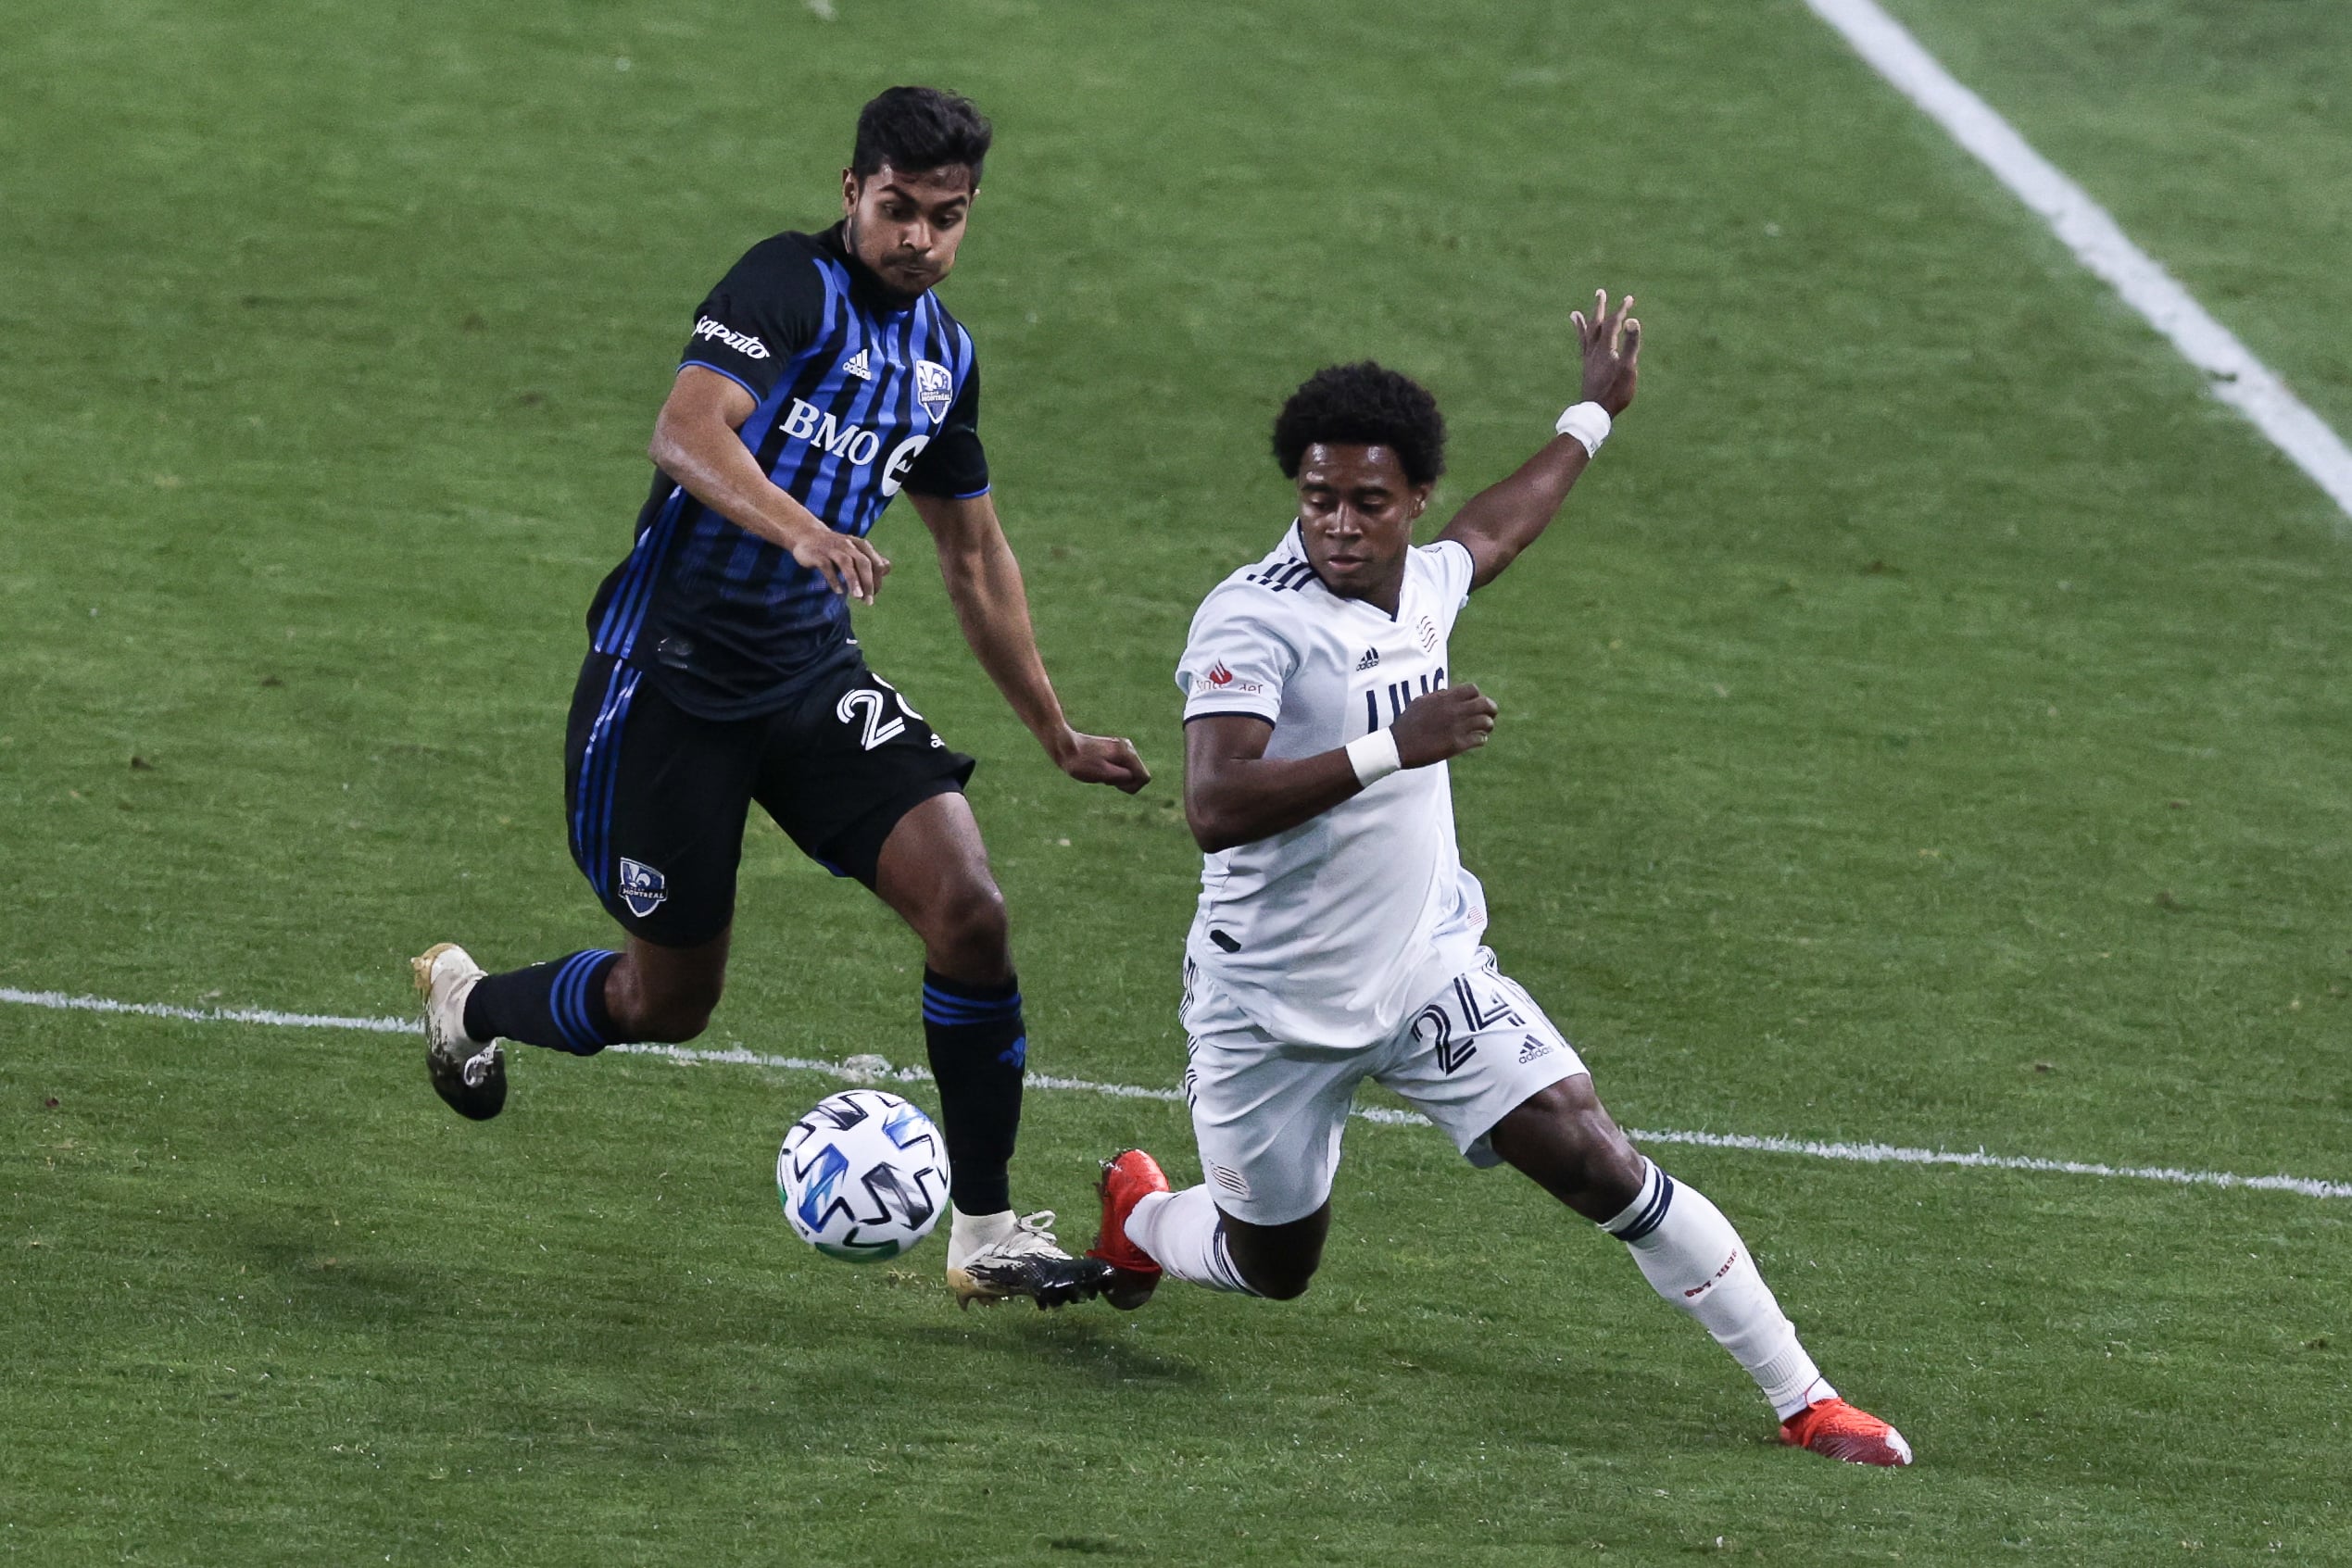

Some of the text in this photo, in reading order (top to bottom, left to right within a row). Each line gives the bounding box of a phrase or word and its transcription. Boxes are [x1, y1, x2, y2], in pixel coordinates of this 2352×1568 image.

[779, 397, 879, 465] BMO
[836, 672, 924, 751] 2
[1410, 973, 1526, 1075] 24
